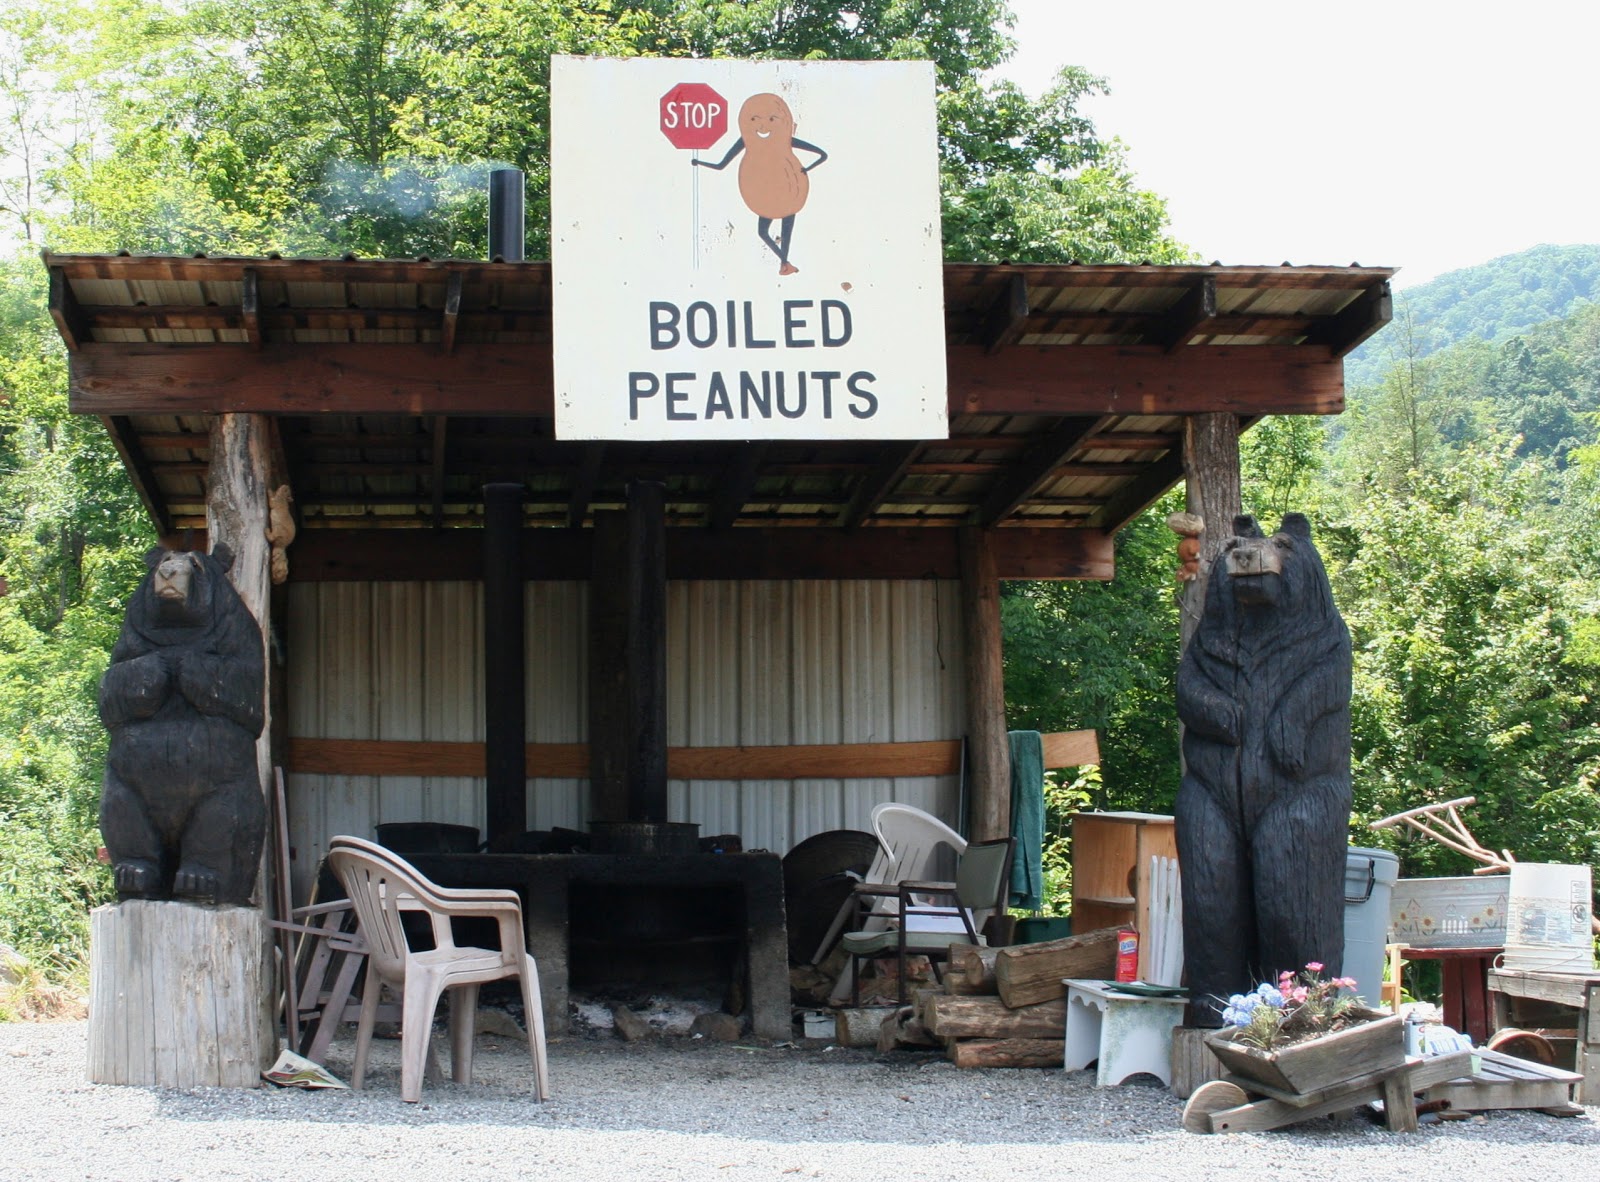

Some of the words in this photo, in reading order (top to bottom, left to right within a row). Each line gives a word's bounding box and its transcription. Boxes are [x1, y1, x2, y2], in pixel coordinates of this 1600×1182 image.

[664, 101, 721, 129] STOP
[649, 299, 853, 350] BOILED
[628, 370, 879, 421] PEANUTS
